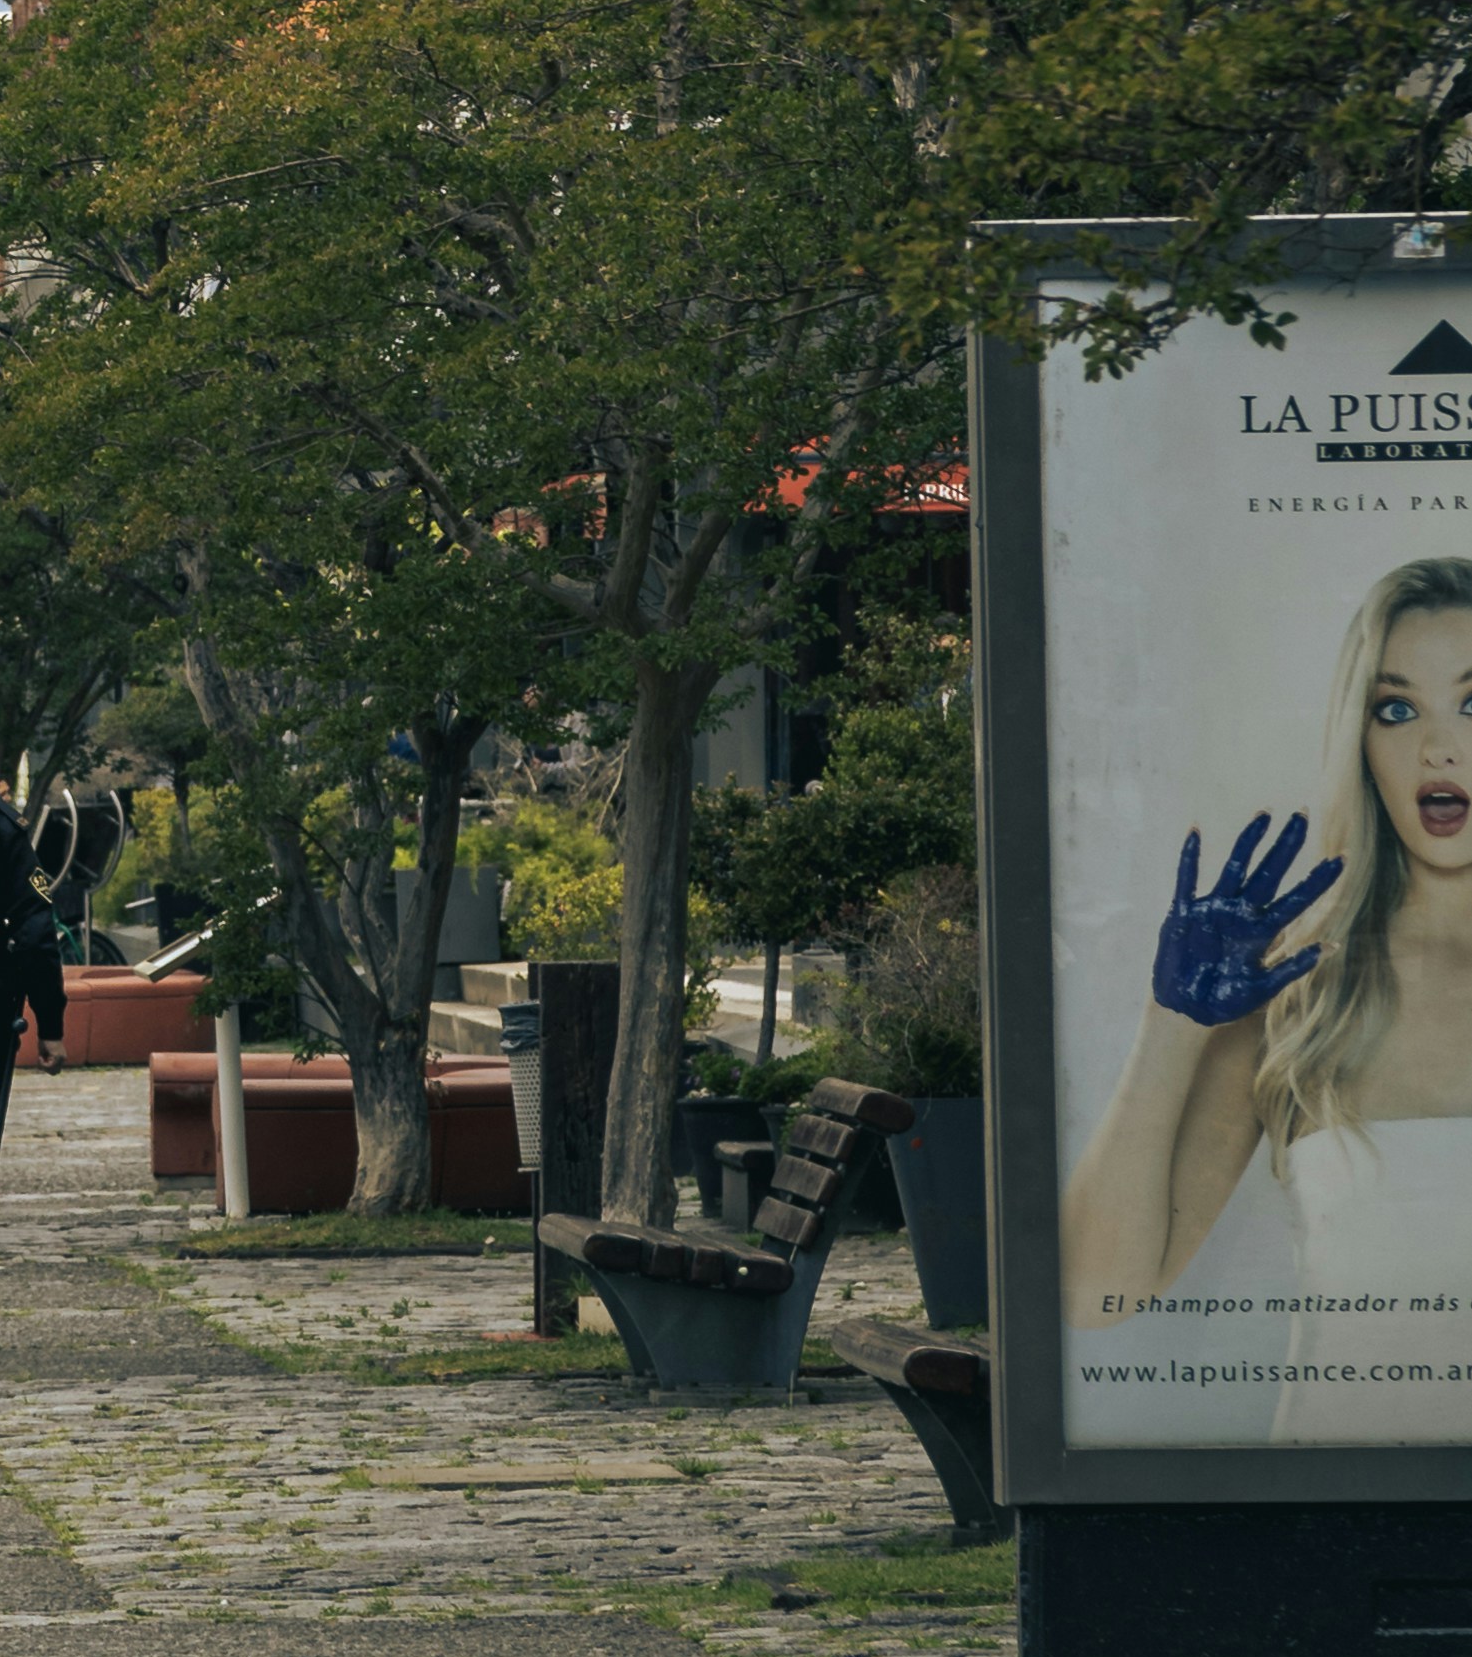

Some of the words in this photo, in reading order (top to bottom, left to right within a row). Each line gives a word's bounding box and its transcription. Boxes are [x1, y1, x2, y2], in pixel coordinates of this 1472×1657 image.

[1239, 394, 1312, 434] LA
[1328, 391, 1472, 433] PUIS
[1248, 493, 1389, 513] ENERGÍA
[1410, 495, 1469, 511] PAR
[1102, 1295, 1124, 1313] El
[1135, 1294, 1254, 1317] shampoo
[1265, 1293, 1398, 1313] matizador
[1409, 1293, 1459, 1312] más
